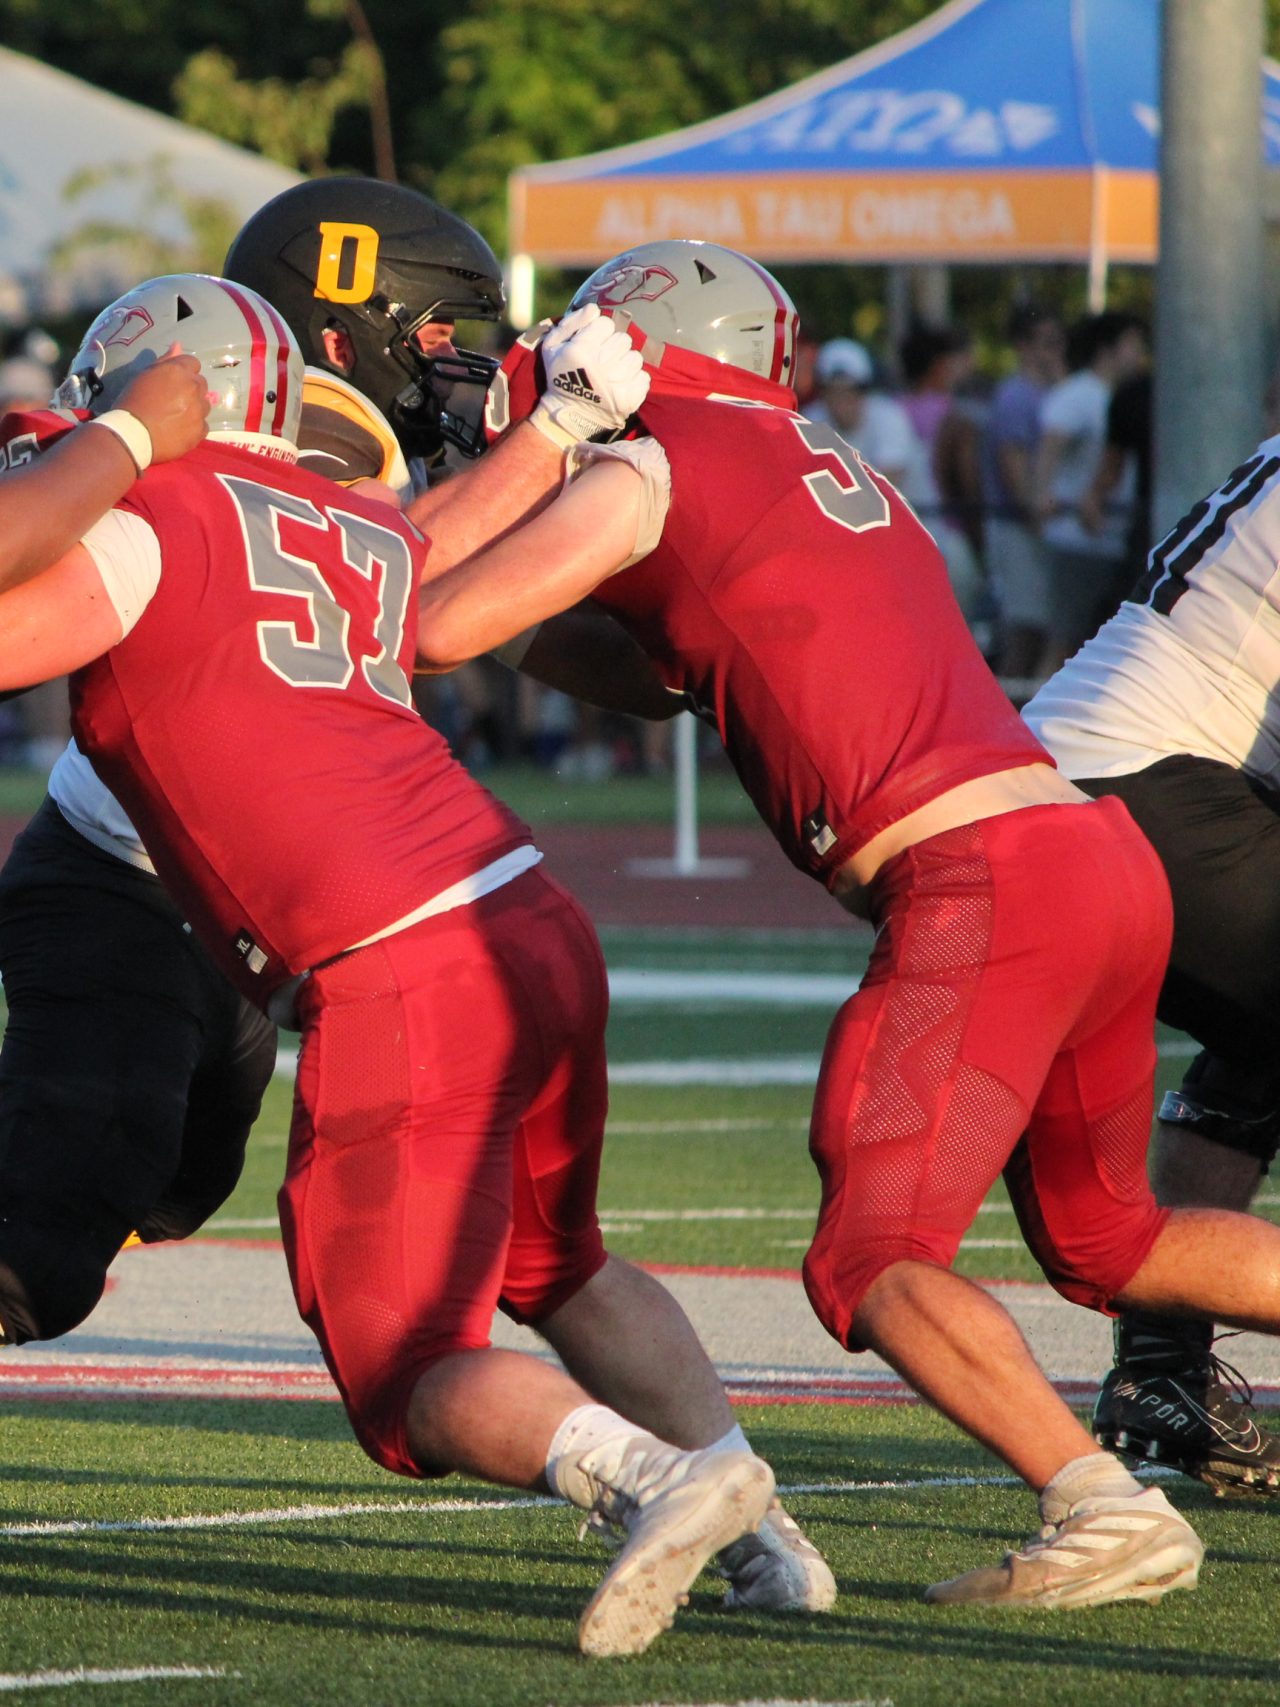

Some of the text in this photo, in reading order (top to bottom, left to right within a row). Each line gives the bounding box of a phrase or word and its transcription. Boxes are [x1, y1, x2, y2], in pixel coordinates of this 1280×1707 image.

[594, 190, 1017, 241] ALPHA TAU OMEGA
[313, 221, 380, 304] D
[553, 377, 602, 404] adidas
[1112, 1378, 1189, 1431] VAPOR
